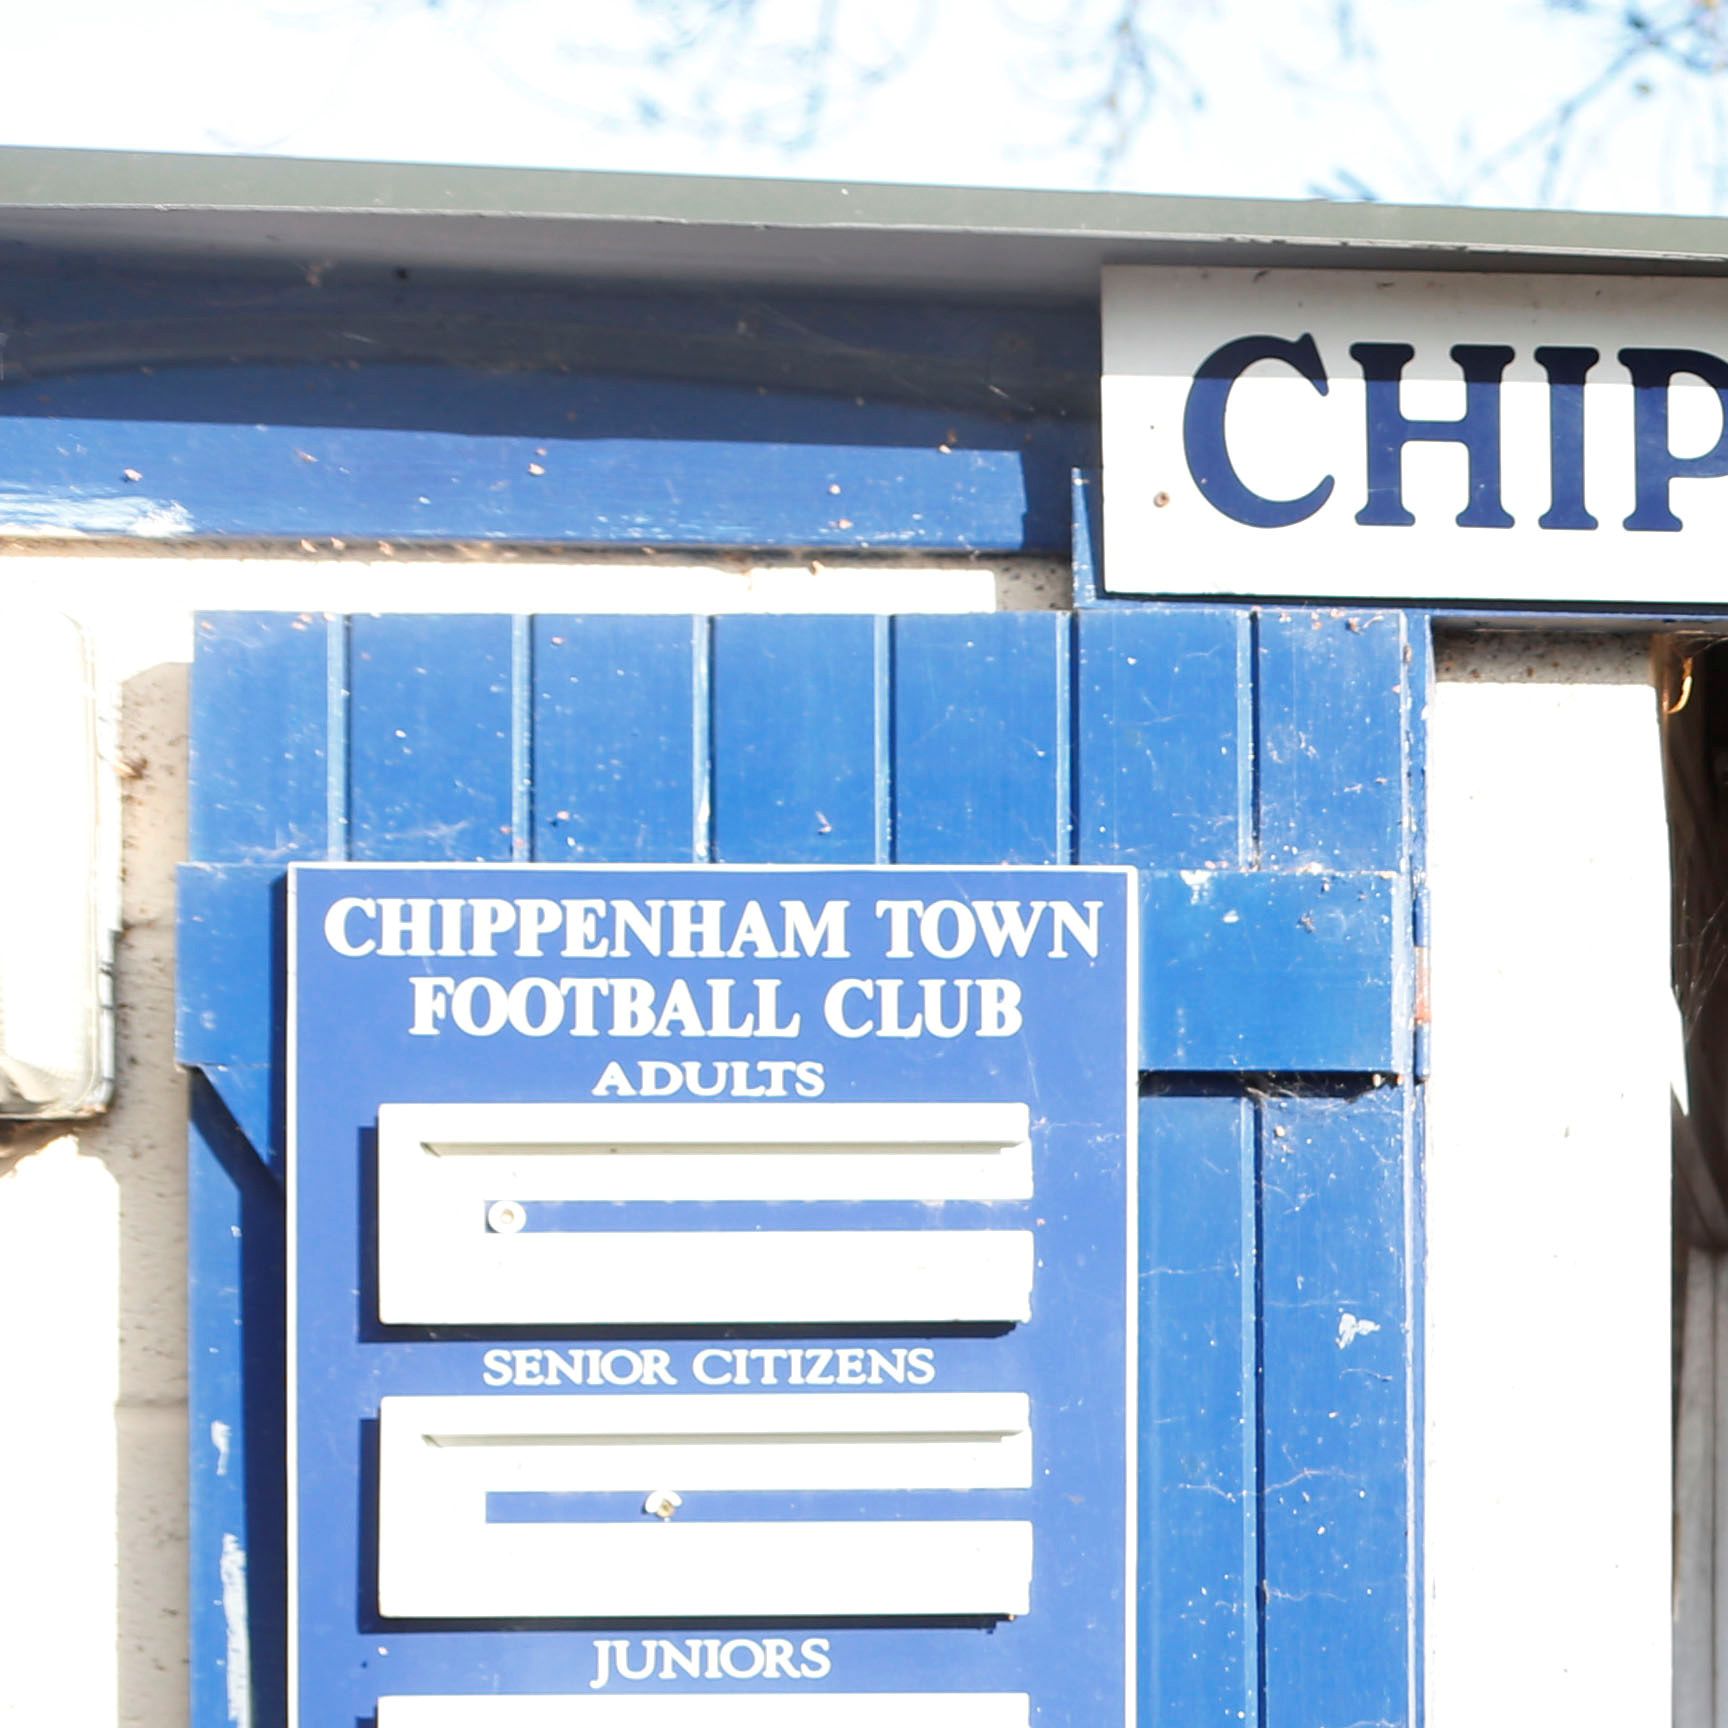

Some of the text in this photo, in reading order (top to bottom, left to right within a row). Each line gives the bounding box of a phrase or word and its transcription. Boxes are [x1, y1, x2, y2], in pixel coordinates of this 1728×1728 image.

[324, 898, 1103, 958] CHIPPENHAM TOWN
[409, 977, 1022, 1037] FOOTBALL CLUB
[592, 1061, 824, 1098] ADULTS
[483, 1348, 935, 1385] SENIOR CITIZENS
[589, 1638, 831, 1689] JUNIORS
